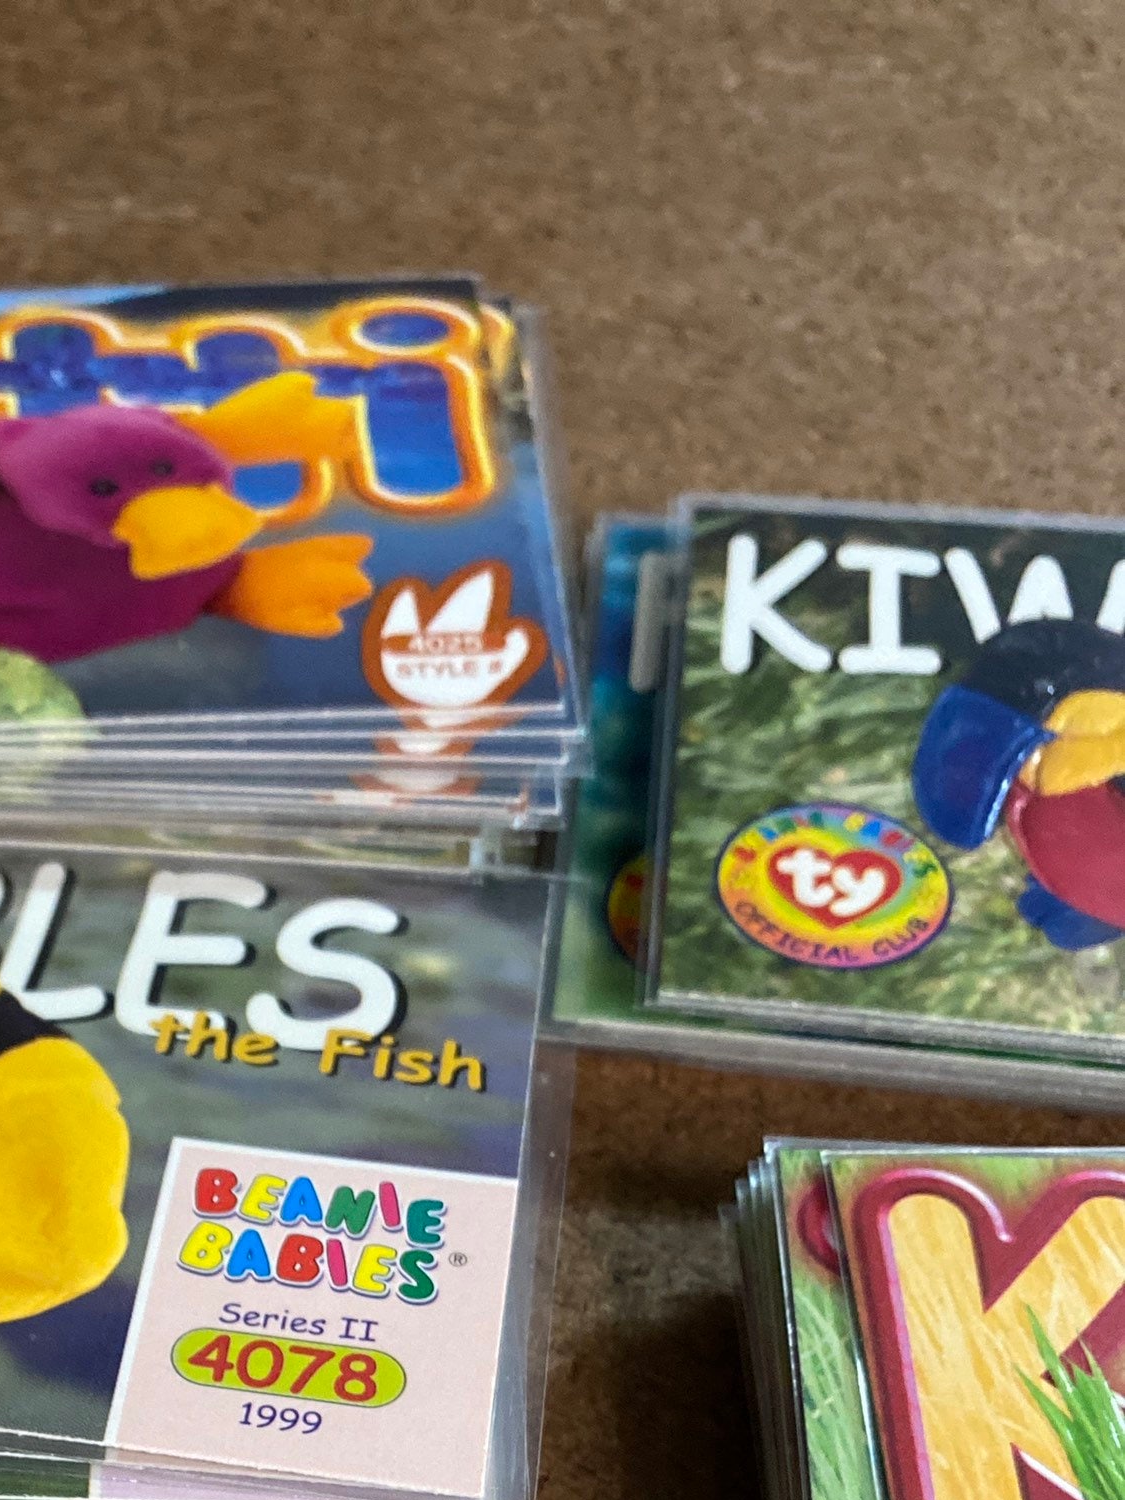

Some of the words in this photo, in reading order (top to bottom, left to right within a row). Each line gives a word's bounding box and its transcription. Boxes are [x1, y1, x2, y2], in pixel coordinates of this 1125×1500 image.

[776, 848, 887, 917] ty
[148, 1012, 279, 1066] the
[319, 1029, 485, 1092] Fish
[194, 1168, 447, 1248] BEANIE
[178, 1220, 439, 1305] BABIES
[218, 1302, 327, 1337] Series
[339, 1317, 379, 1342] II
[187, 1333, 378, 1403] 4078
[239, 1402, 324, 1435] 1999
